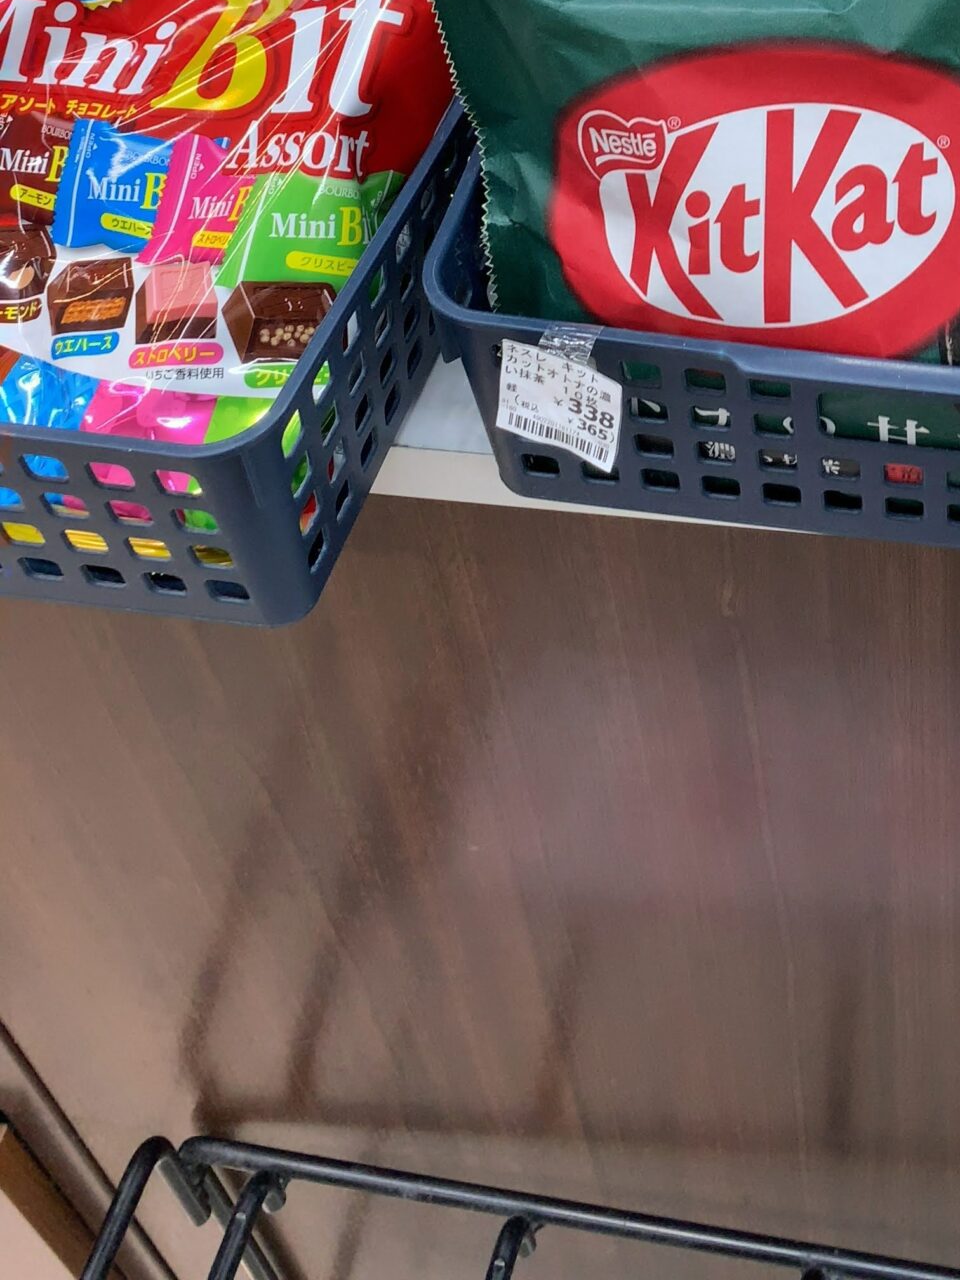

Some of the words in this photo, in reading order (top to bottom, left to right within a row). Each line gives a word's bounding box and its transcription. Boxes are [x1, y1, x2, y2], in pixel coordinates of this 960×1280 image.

[0, 93, 56, 115] アソート
[65, 99, 138, 119] チョコレート
[225, 119, 370, 177] Assort
[87, 174, 141, 203] Mini
[188, 195, 235, 220] Mini
[629, 108, 939, 325] KitKat
[269, 212, 336, 239] Mini
[55, 334, 113, 355] ウエハース
[135, 348, 216, 367] ストロベリー
[145, 366, 225, 382] いちご香料使用
[506, 343, 547, 363] ネスレ
[561, 361, 600, 384] キット
[552, 396, 615, 430] ¥338
